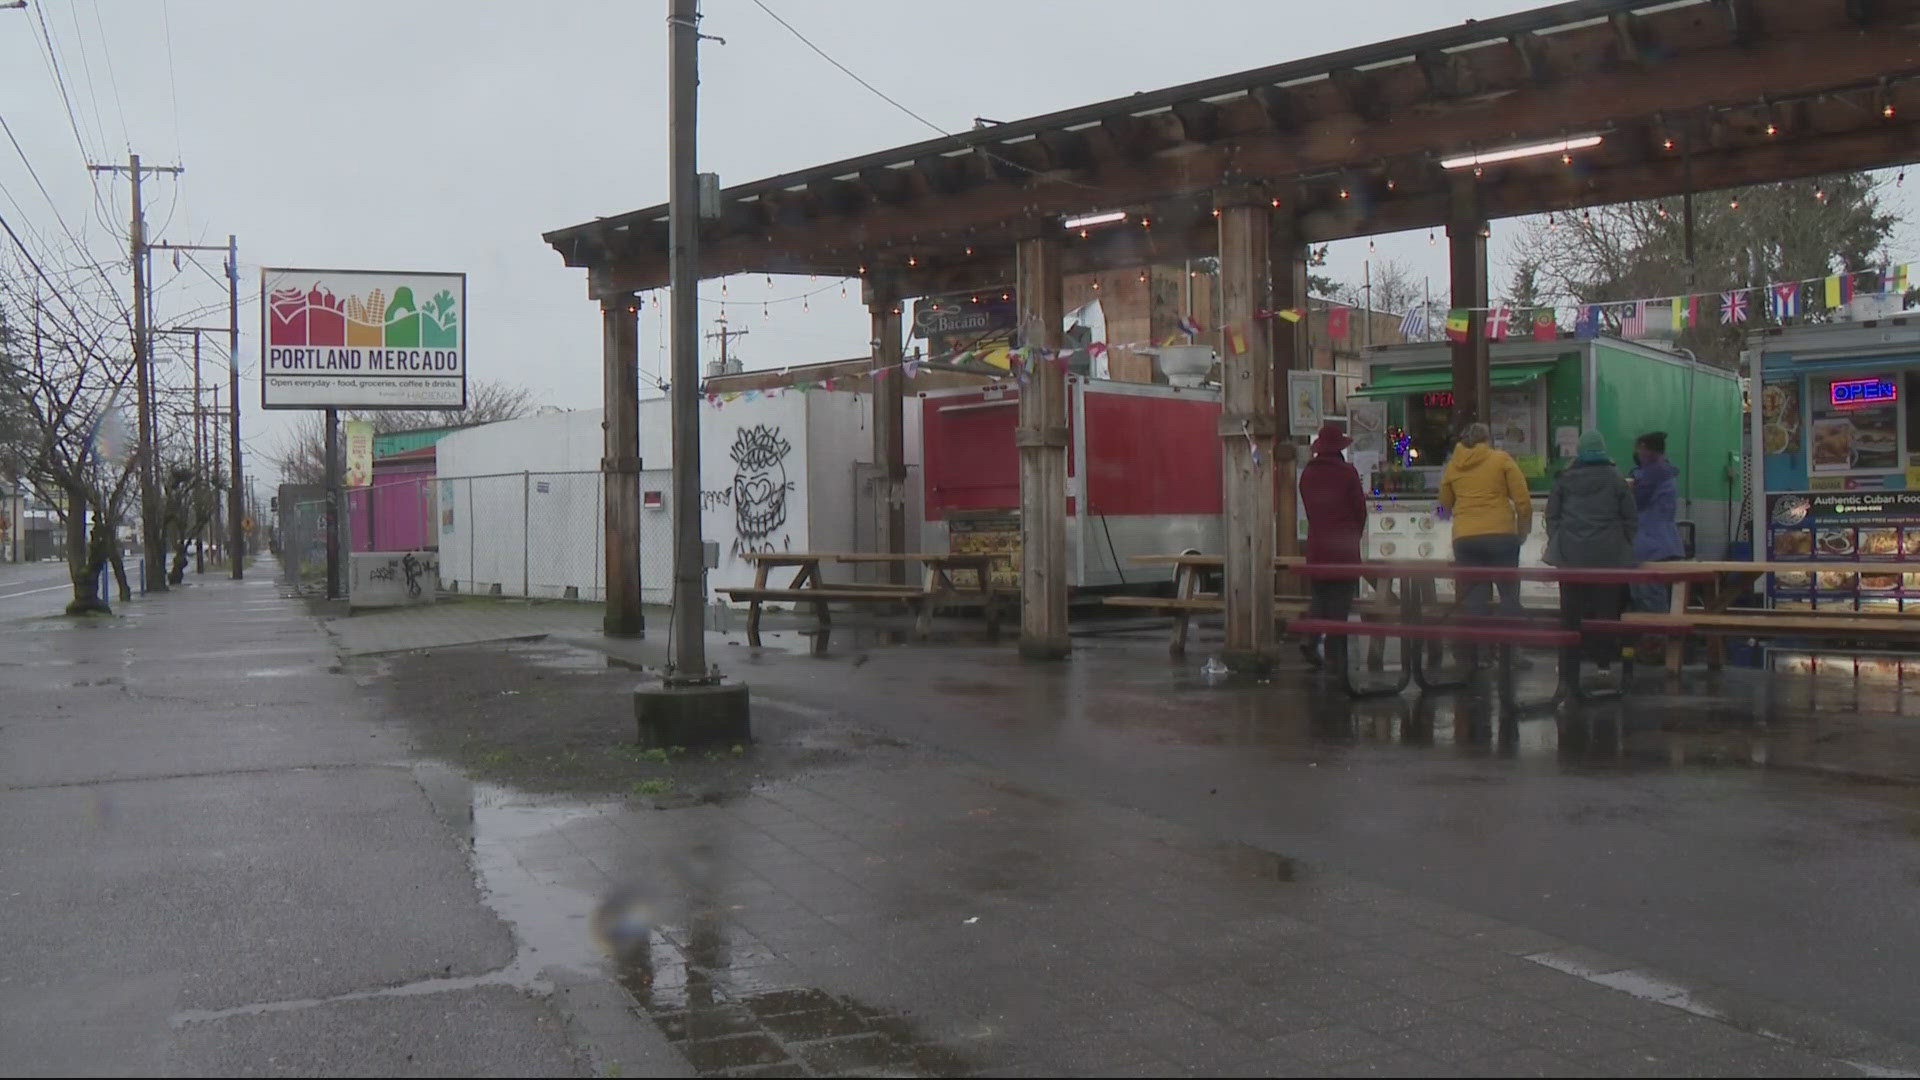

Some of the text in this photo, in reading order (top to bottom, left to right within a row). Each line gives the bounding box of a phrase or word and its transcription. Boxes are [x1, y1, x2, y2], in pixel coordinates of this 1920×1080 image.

[270, 349, 457, 371] PORTLAND MERCADO
[270, 378, 293, 387] Open
[294, 379, 331, 388] everyday
[1834, 382, 1893, 400] OPEN
[1814, 495, 1861, 506] Authentic
[1863, 494, 1895, 505] Cuban
